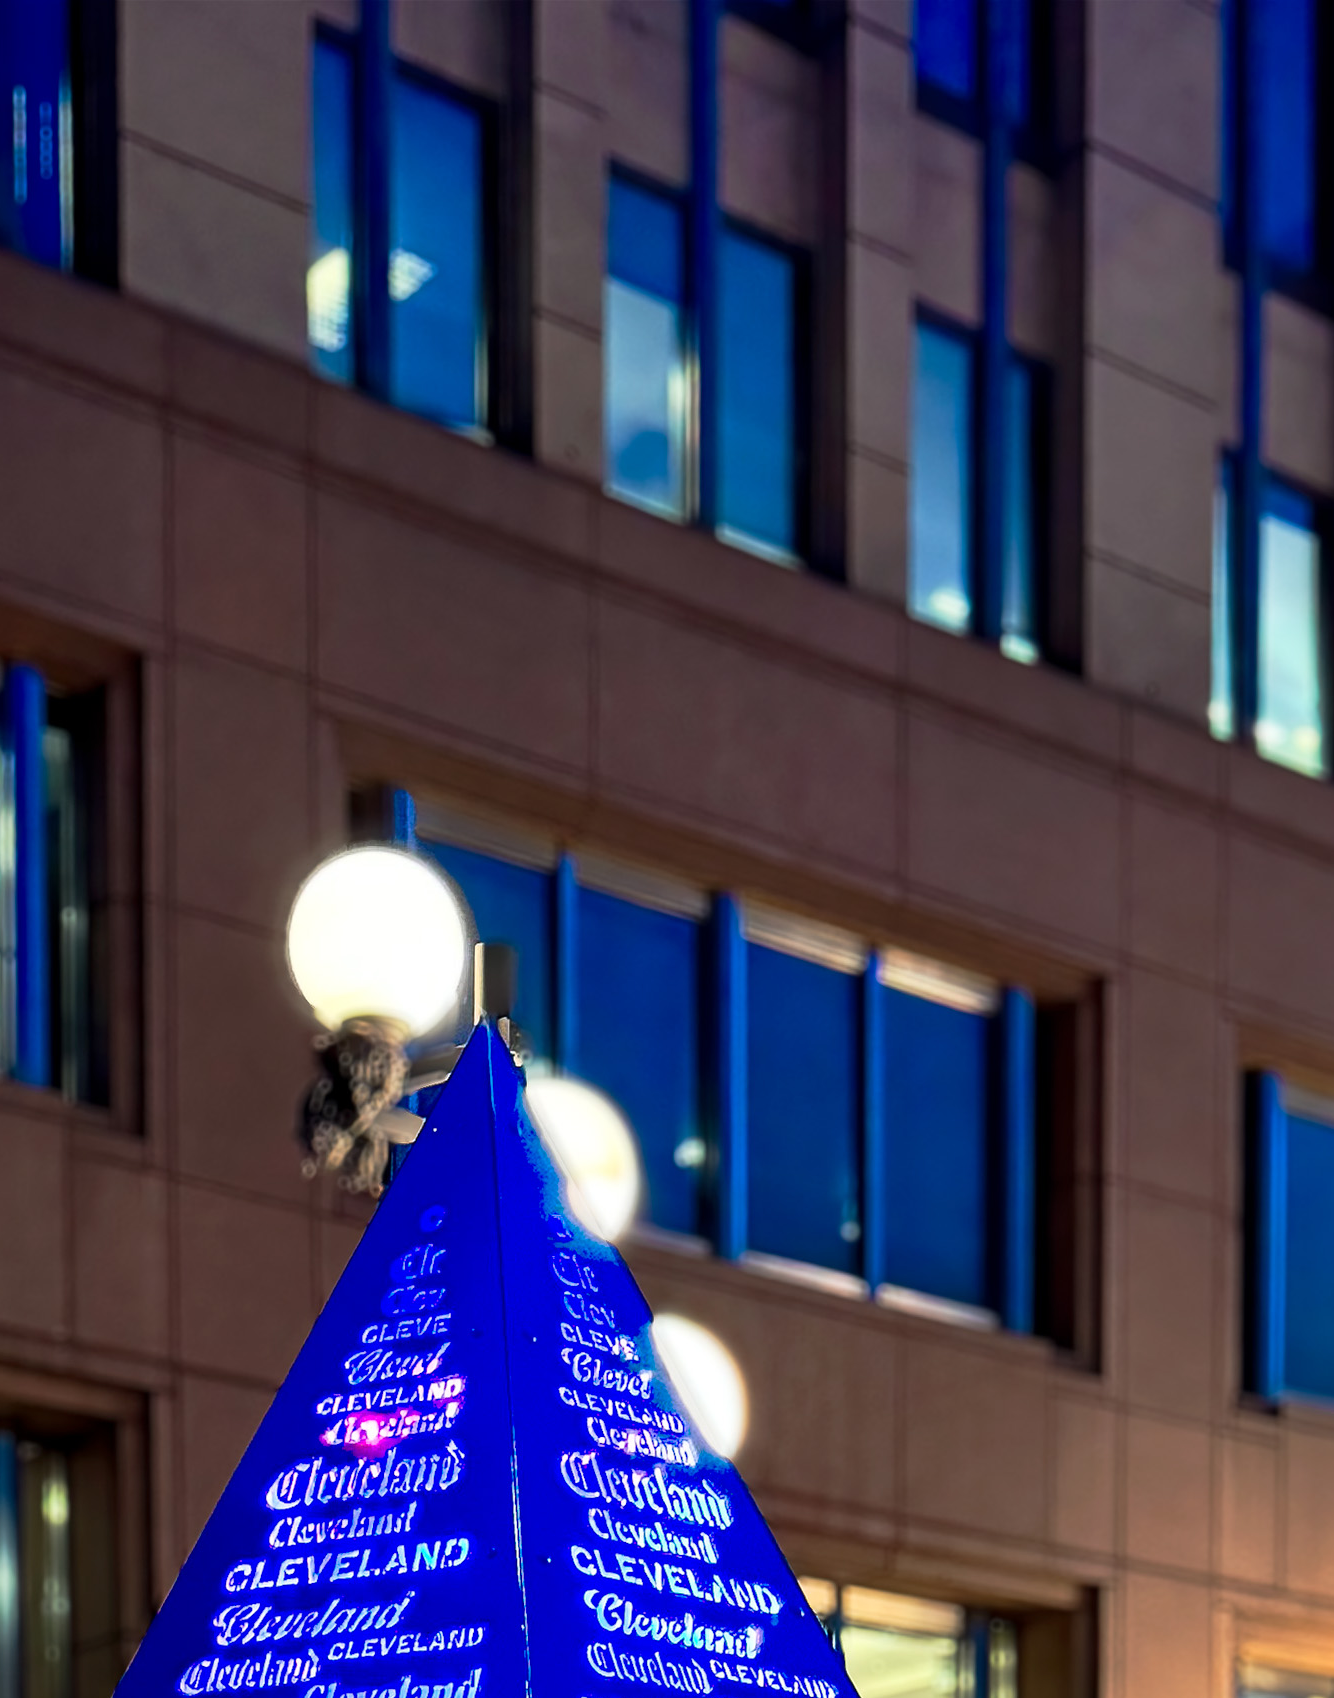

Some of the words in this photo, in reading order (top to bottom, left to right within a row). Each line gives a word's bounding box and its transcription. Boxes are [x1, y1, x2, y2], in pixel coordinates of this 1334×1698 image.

[362, 1313, 451, 1343] CLEVE
[560, 1321, 640, 1362] CLEVE
[316, 1375, 465, 1416] CLEVELAND
[558, 1385, 686, 1434] CLEVELAND
[586, 1416, 700, 1467] Cleveland
[265, 1440, 465, 1510] Cleveland
[560, 1450, 736, 1532] Cleveland
[269, 1501, 417, 1550] Cleveland
[588, 1508, 719, 1564] Cleveland
[226, 1538, 469, 1597] CLEVELAND
[571, 1543, 785, 1618] CLEVELAND
[213, 1591, 415, 1647] Cleveland
[327, 1627, 483, 1660] CLEVELAND
[583, 1587, 765, 1666] Cleveland
[178, 1648, 321, 1696] Cleveland
[587, 1642, 714, 1694] Cleveland
